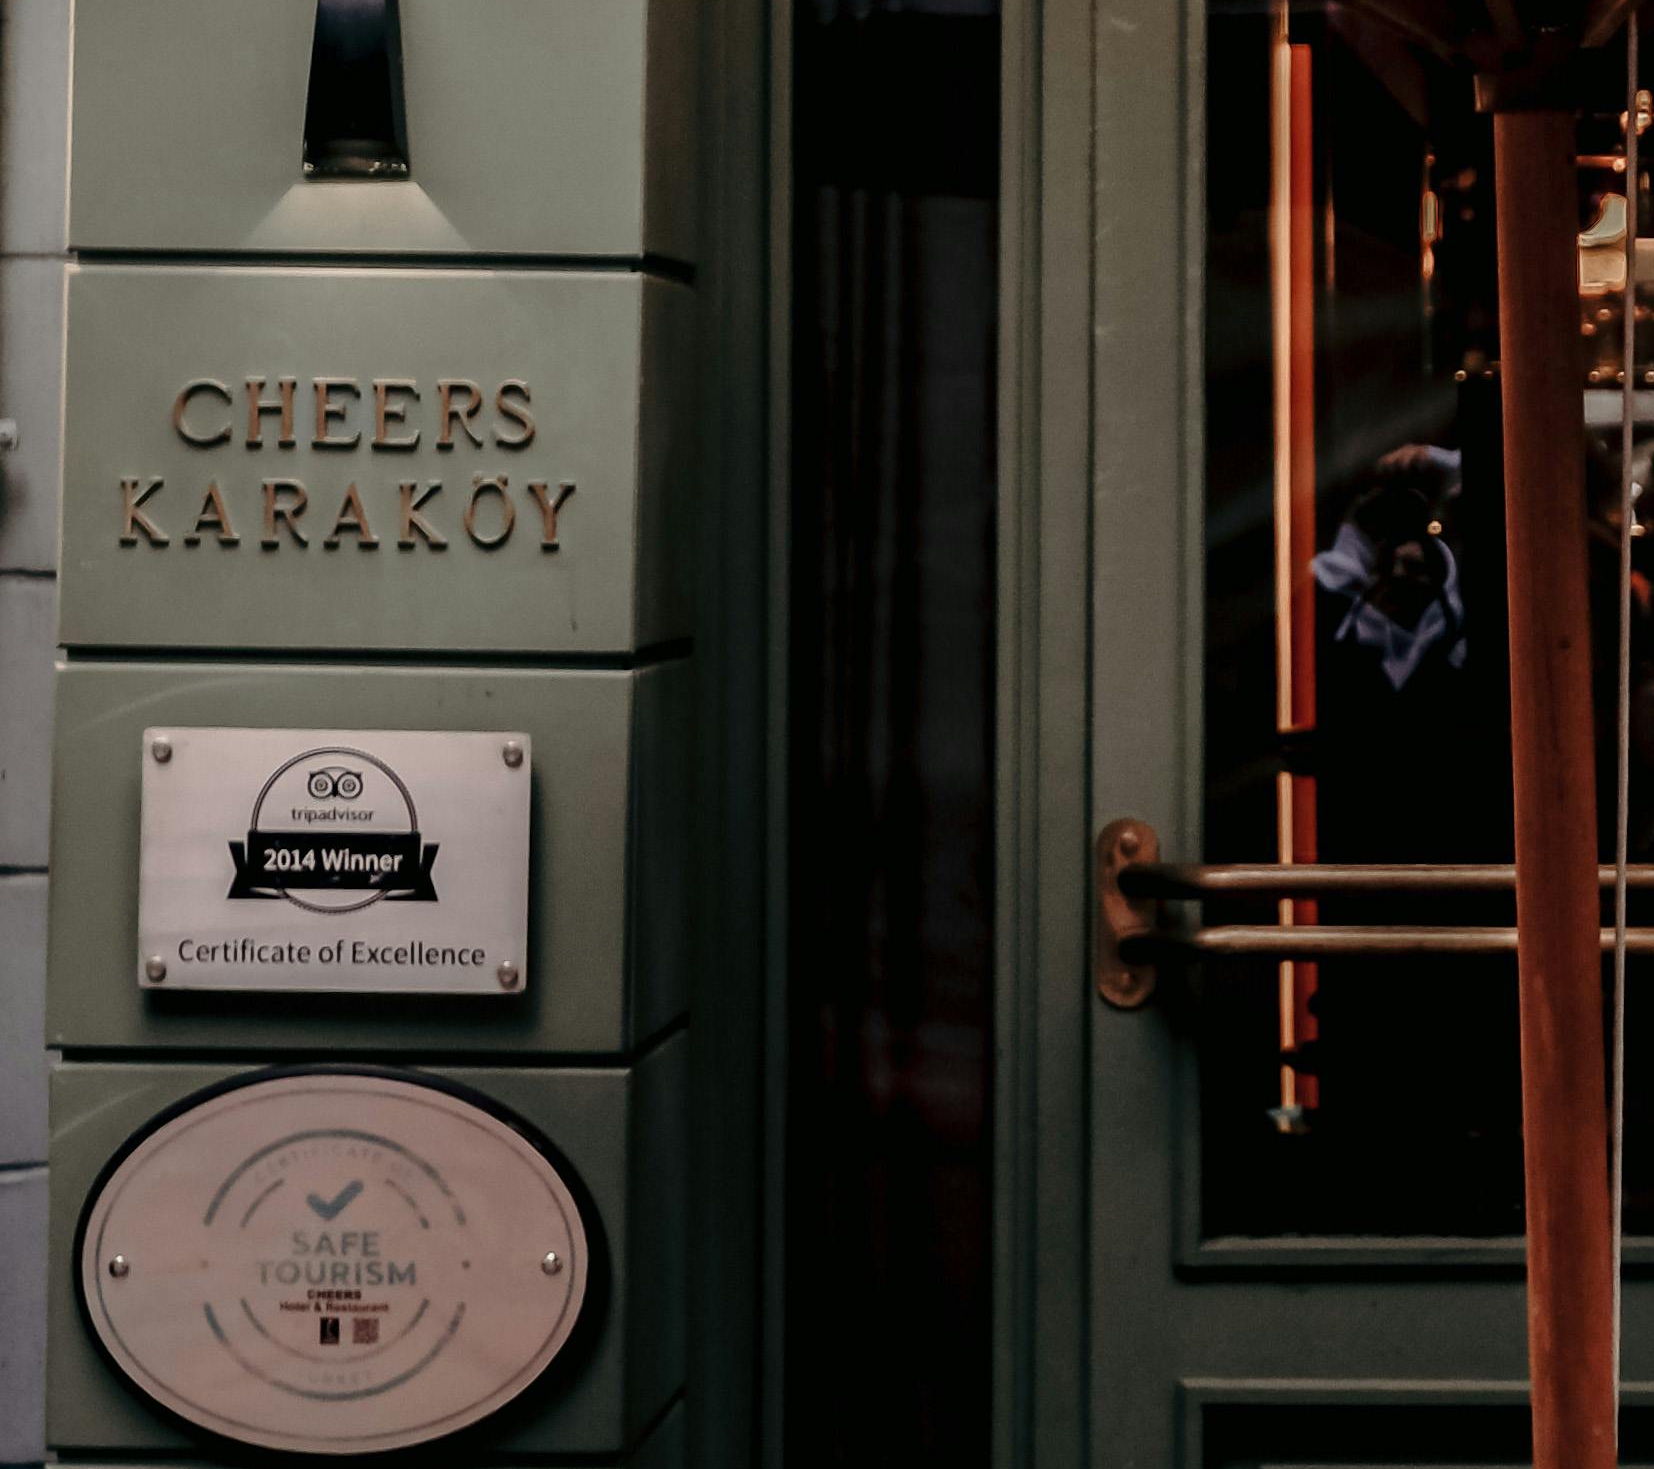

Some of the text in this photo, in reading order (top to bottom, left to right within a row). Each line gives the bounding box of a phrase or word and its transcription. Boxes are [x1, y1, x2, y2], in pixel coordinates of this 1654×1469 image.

[172, 376, 536, 450] CHEERS
[119, 471, 576, 553] KARAKÖY
[291, 807, 375, 824] tripadvisor
[263, 848, 404, 872] 2014 Winner
[178, 939, 487, 966] Certificate of Excellence
[292, 1231, 380, 1256] SAFE
[259, 1261, 417, 1286] TOURISM
